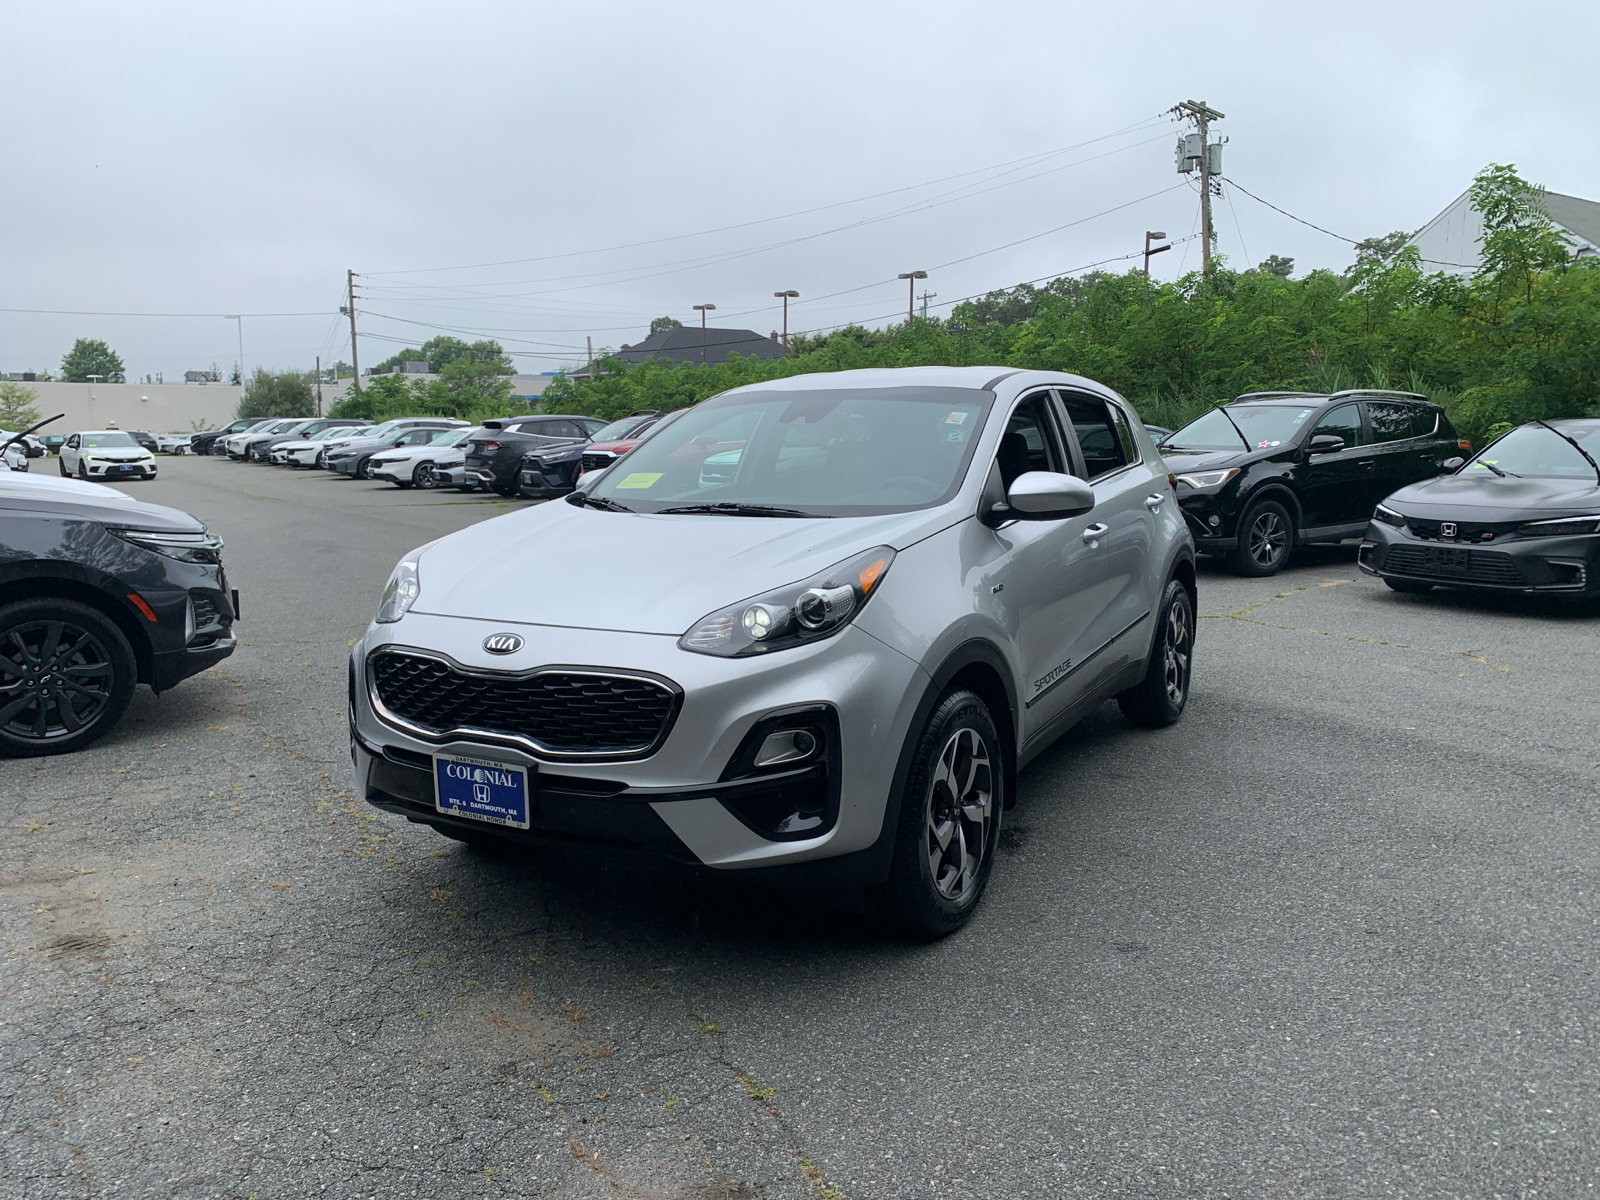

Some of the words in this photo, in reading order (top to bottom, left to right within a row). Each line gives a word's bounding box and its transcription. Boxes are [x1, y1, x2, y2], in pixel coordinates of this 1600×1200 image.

[487, 636, 515, 650] KIA
[1034, 658, 1072, 692] SPORTAGE
[446, 764, 517, 788] COLONIAL
[458, 811, 485, 820] COLONIAL
[486, 816, 507, 825] HONDA
